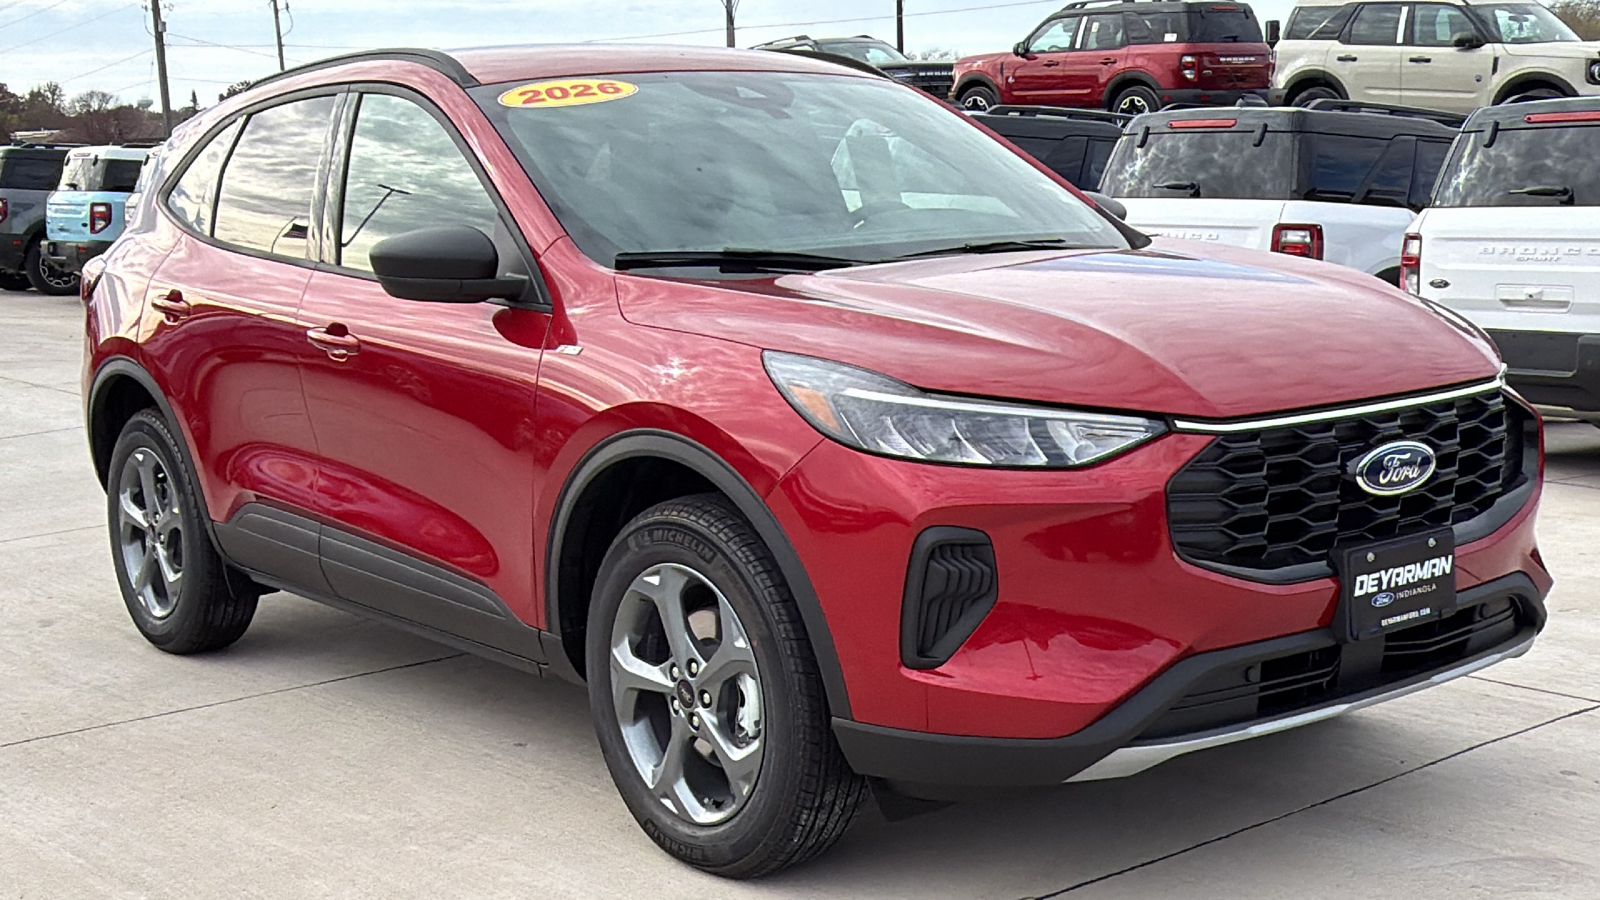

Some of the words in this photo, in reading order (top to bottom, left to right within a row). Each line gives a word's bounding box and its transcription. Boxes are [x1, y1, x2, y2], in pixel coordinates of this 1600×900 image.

[518, 83, 623, 104] 2026
[1379, 452, 1422, 484] Ford
[653, 529, 714, 559] MICHELIN
[1354, 554, 1453, 597] DEYARMAN
[1396, 583, 1437, 600] INDIANOLA
